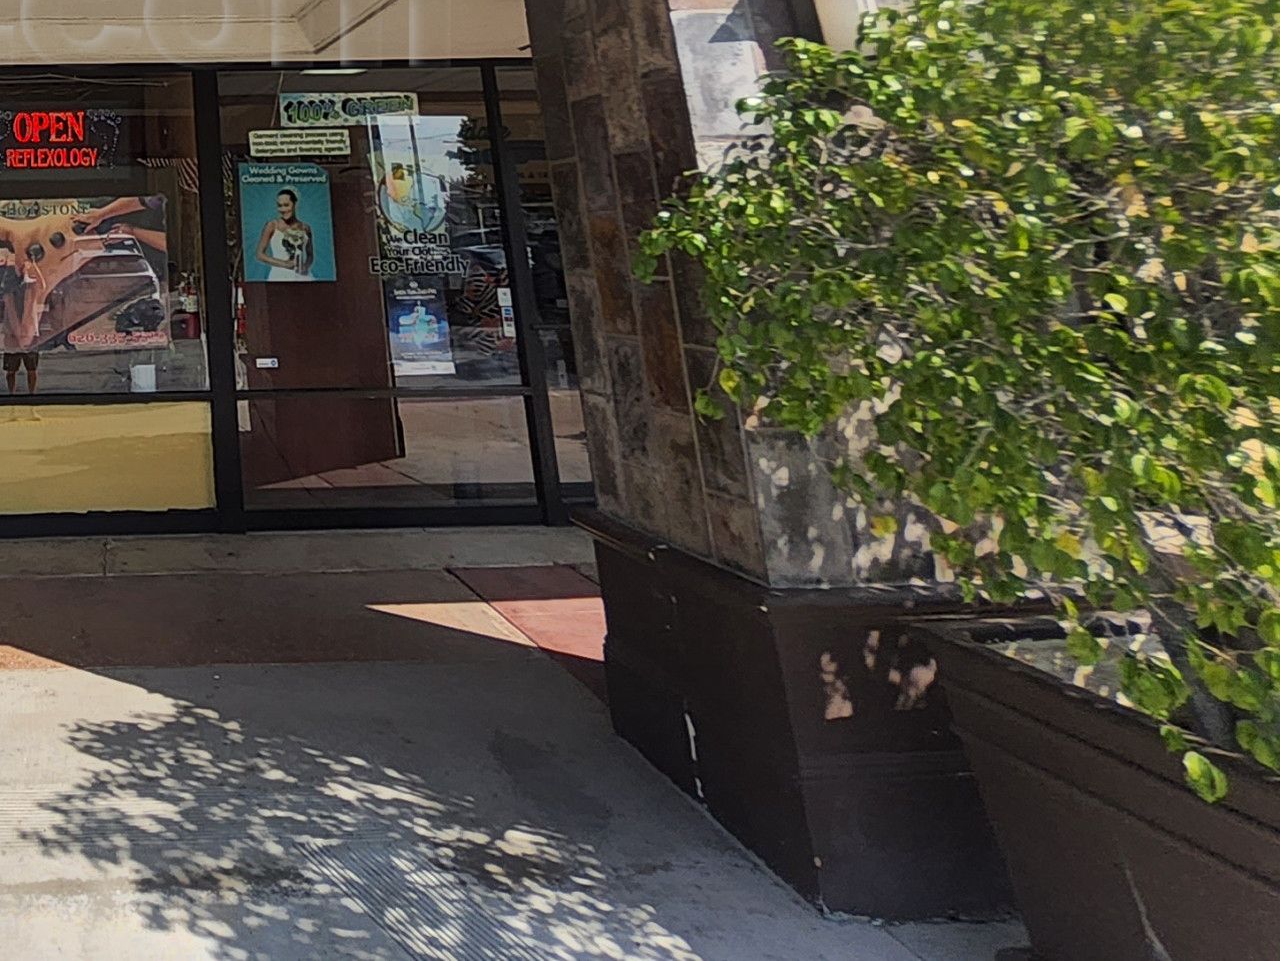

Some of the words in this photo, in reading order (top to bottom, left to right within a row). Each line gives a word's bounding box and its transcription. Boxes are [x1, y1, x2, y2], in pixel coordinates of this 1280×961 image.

[283, 98, 340, 123] 100%
[342, 95, 413, 117] GREEN
[13, 111, 85, 143] OPEN
[6, 148, 98, 168] REFLEXOLOGY
[241, 175, 274, 183] Cleaned
[276, 175, 283, 183] &
[285, 174, 327, 183] Preserved
[249, 166, 286, 176] Wedding
[288, 166, 318, 174] Gowns
[403, 228, 449, 245] Clean
[385, 246, 410, 256] Your
[369, 256, 470, 277] Eco-Friendly
